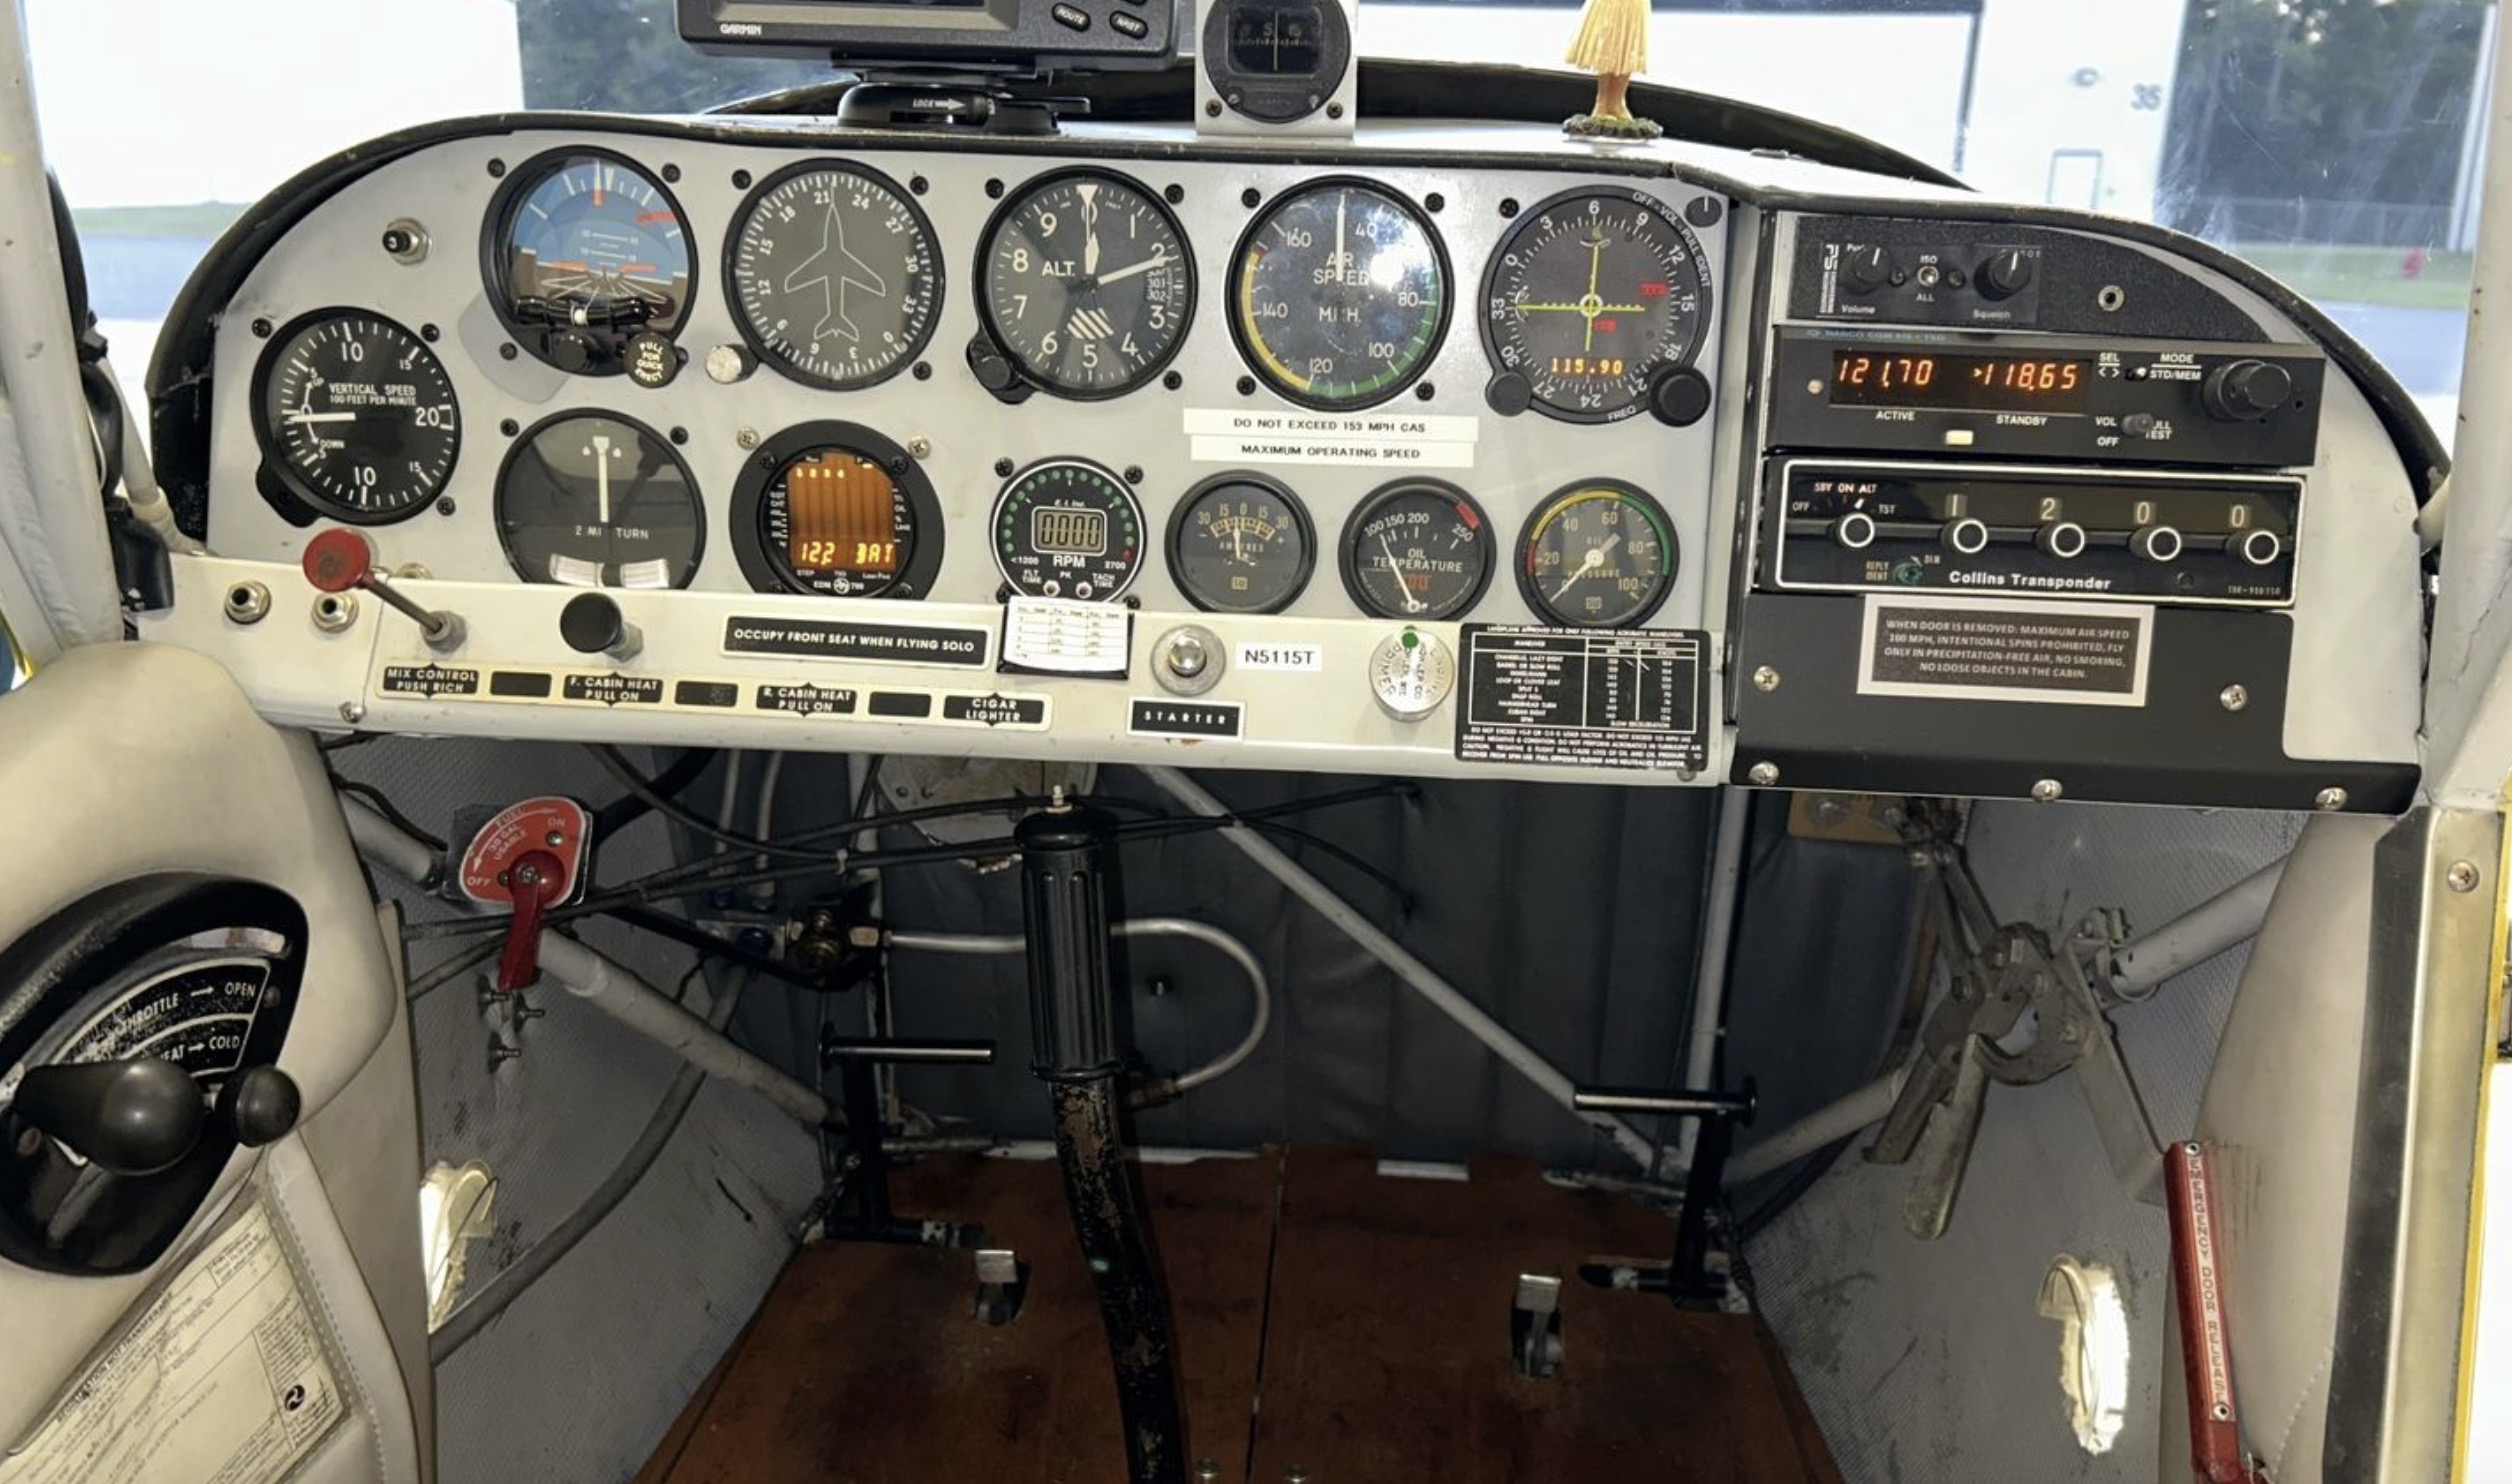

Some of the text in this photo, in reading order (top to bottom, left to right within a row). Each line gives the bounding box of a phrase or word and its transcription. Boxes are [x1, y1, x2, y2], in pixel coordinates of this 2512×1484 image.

[1058, 7, 1087, 25] ROUTE
[720, 24, 762, 36] GARMIN
[1040, 213, 1057, 238] 9
[1129, 214, 1137, 239] 1
[1355, 223, 1379, 239] 40
[389, 236, 397, 249] 3
[1286, 231, 1312, 249] 160
[1012, 247, 1029, 272] 8
[1326, 252, 1354, 268] AR
[1920, 254, 1937, 263] ISO
[1042, 261, 1076, 278] ALT.
[1313, 268, 1370, 287] SPED
[1397, 292, 1419, 308] 80
[1917, 294, 1934, 302] ALL
[1013, 295, 1028, 319] 7
[1262, 302, 1289, 319] 140
[1842, 304, 1876, 314] Volume
[1149, 305, 1165, 330] 3
[1041, 331, 1058, 355] 6
[1121, 332, 1140, 357] 4
[1369, 342, 1396, 358] 100
[342, 342, 364, 362] 10
[1082, 344, 1099, 369] 5
[2099, 352, 2120, 362] SEL
[2160, 353, 2195, 364] MODE
[1309, 358, 1333, 374] 120
[1551, 358, 1623, 374] 115.90
[2150, 370, 2202, 380] STD/MEM
[329, 382, 417, 397] VERTICAL SPEED
[330, 395, 417, 406] 100 FEET PER MINUTE
[415, 407, 440, 427] 20
[1876, 411, 1915, 421] ACTIVE
[1997, 415, 2048, 426] STANDBY
[2096, 416, 2117, 427] VOL
[1233, 417, 1427, 433] DO NOT EXCEED 153 MPH CAS
[320, 440, 345, 449] DOWN
[2097, 437, 2119, 447] OFF
[1241, 445, 1421, 459] MAXIMUM OPERATING SPEED
[355, 466, 376, 487] 10
[1838, 484, 1855, 493] ON
[1858, 484, 1878, 493] ALT
[1792, 502, 1810, 511] OFF
[2040, 497, 2056, 521] 2
[2137, 502, 2150, 524] 0
[1386, 512, 1431, 528] 150 200
[2233, 505, 2246, 527] 0
[616, 527, 650, 540] TURN
[1452, 523, 1474, 541] 250
[801, 541, 836, 566] 122
[1053, 555, 1087, 568] RPM
[1408, 548, 1426, 559] OIL
[1372, 556, 1463, 573] TEPERATURE
[1950, 571, 2112, 591] Collins Transponder
[1886, 620, 1918, 630] WHEN
[1919, 620, 1950, 631] DOOR
[1952, 622, 1962, 631] IS
[2020, 625, 2076, 637] MAXIMUM
[2078, 627, 2096, 637] AIR
[2098, 629, 2130, 640] SPEED
[734, 629, 976, 652] OCCUPY FRONT SEAT WHEN FLYING SOLO
[1937, 636, 2006, 647] INTENTIONAL
[2009, 638, 2038, 649] SPINS
[2108, 642, 2124, 653] FLY
[1244, 649, 1316, 665] N5115T
[1884, 647, 1911, 657] ONLY
[1912, 648, 1925, 658] IN
[2055, 654, 2071, 664] NO
[387, 669, 475, 683] MIX CONTROL
[1920, 662, 1936, 671] NO
[1938, 662, 1970, 673] LOOSE
[1973, 664, 2016, 675] OBJECTS
[2017, 666, 2030, 676] IN
[2032, 667, 2050, 677] THE
[397, 681, 464, 693] PUSH RICH
[585, 678, 624, 689] CABIN
[628, 680, 658, 692] HEAT
[585, 690, 640, 702] PULL ON
[778, 688, 817, 700] CABIN
[821, 689, 852, 701] HEAT
[779, 700, 834, 713] PULL ON
[973, 699, 1018, 711] CIGAR
[966, 709, 1022, 722] LIGHTER
[1145, 710, 1226, 725] STARTER
[467, 876, 492, 887] OFF
[225, 982, 257, 998] OPEN
[209, 1035, 241, 1052] COLD
[2189, 1158, 2227, 1402] EMERGENCY DOOR RELEASE
